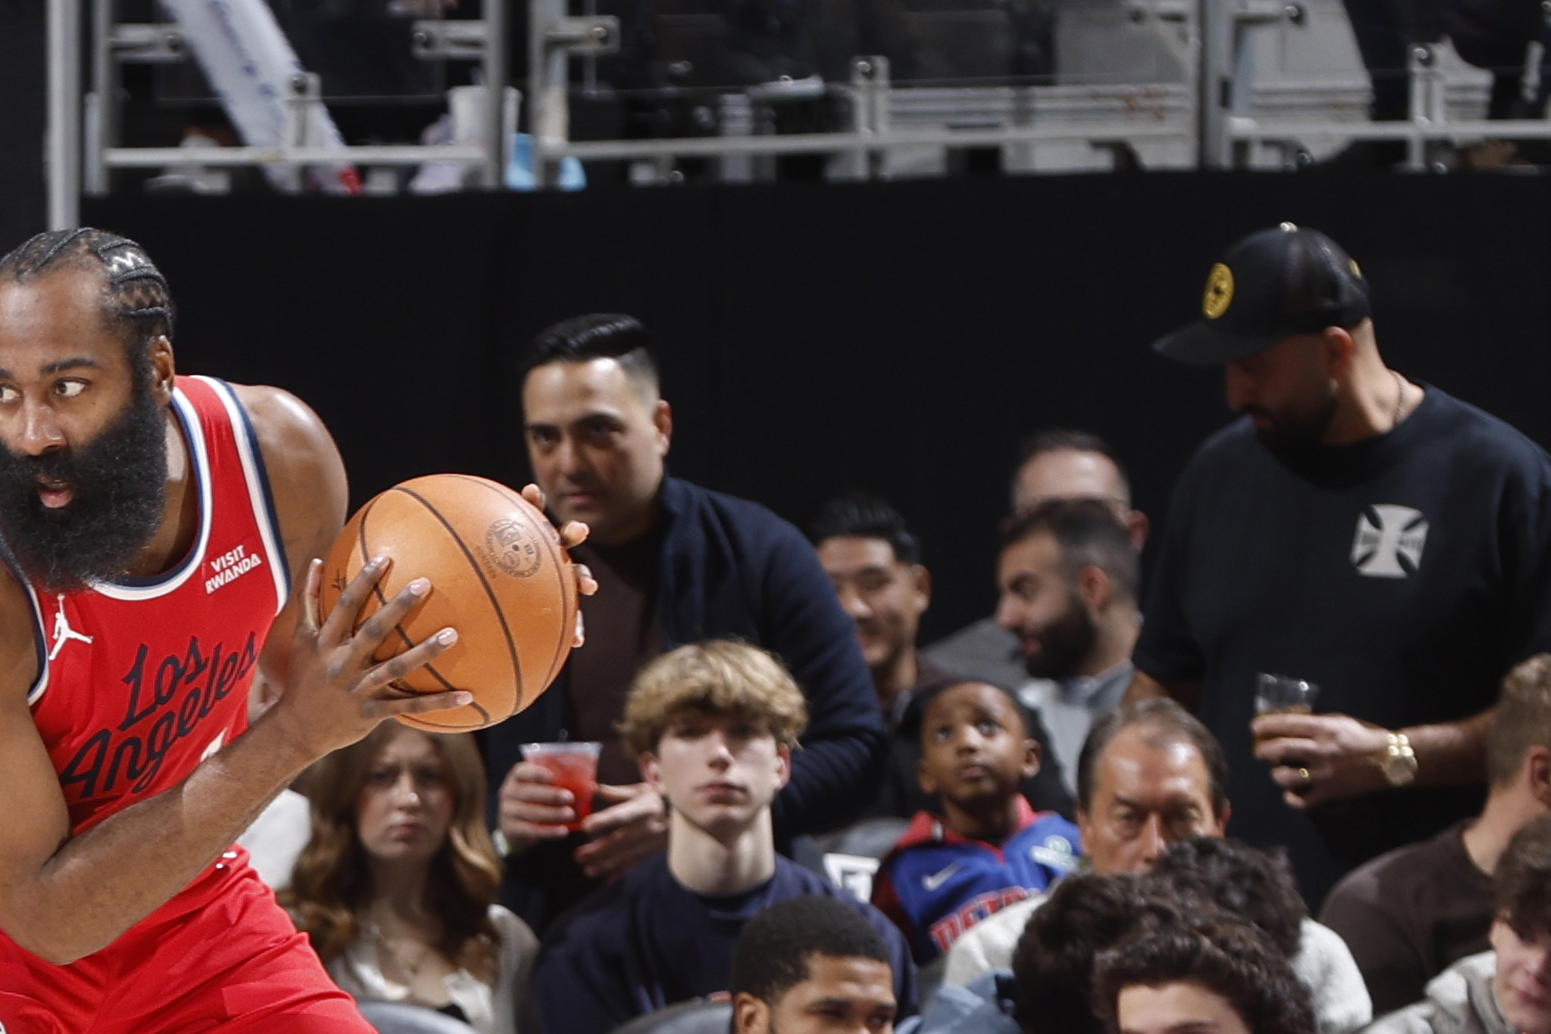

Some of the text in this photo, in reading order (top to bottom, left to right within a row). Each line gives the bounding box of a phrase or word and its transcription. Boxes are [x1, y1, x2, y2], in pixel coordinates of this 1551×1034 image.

[205, 553, 262, 595] RWANDA
[210, 545, 245, 573] VISIT
[59, 632, 256, 798] Angeles
[117, 635, 206, 731] Los
